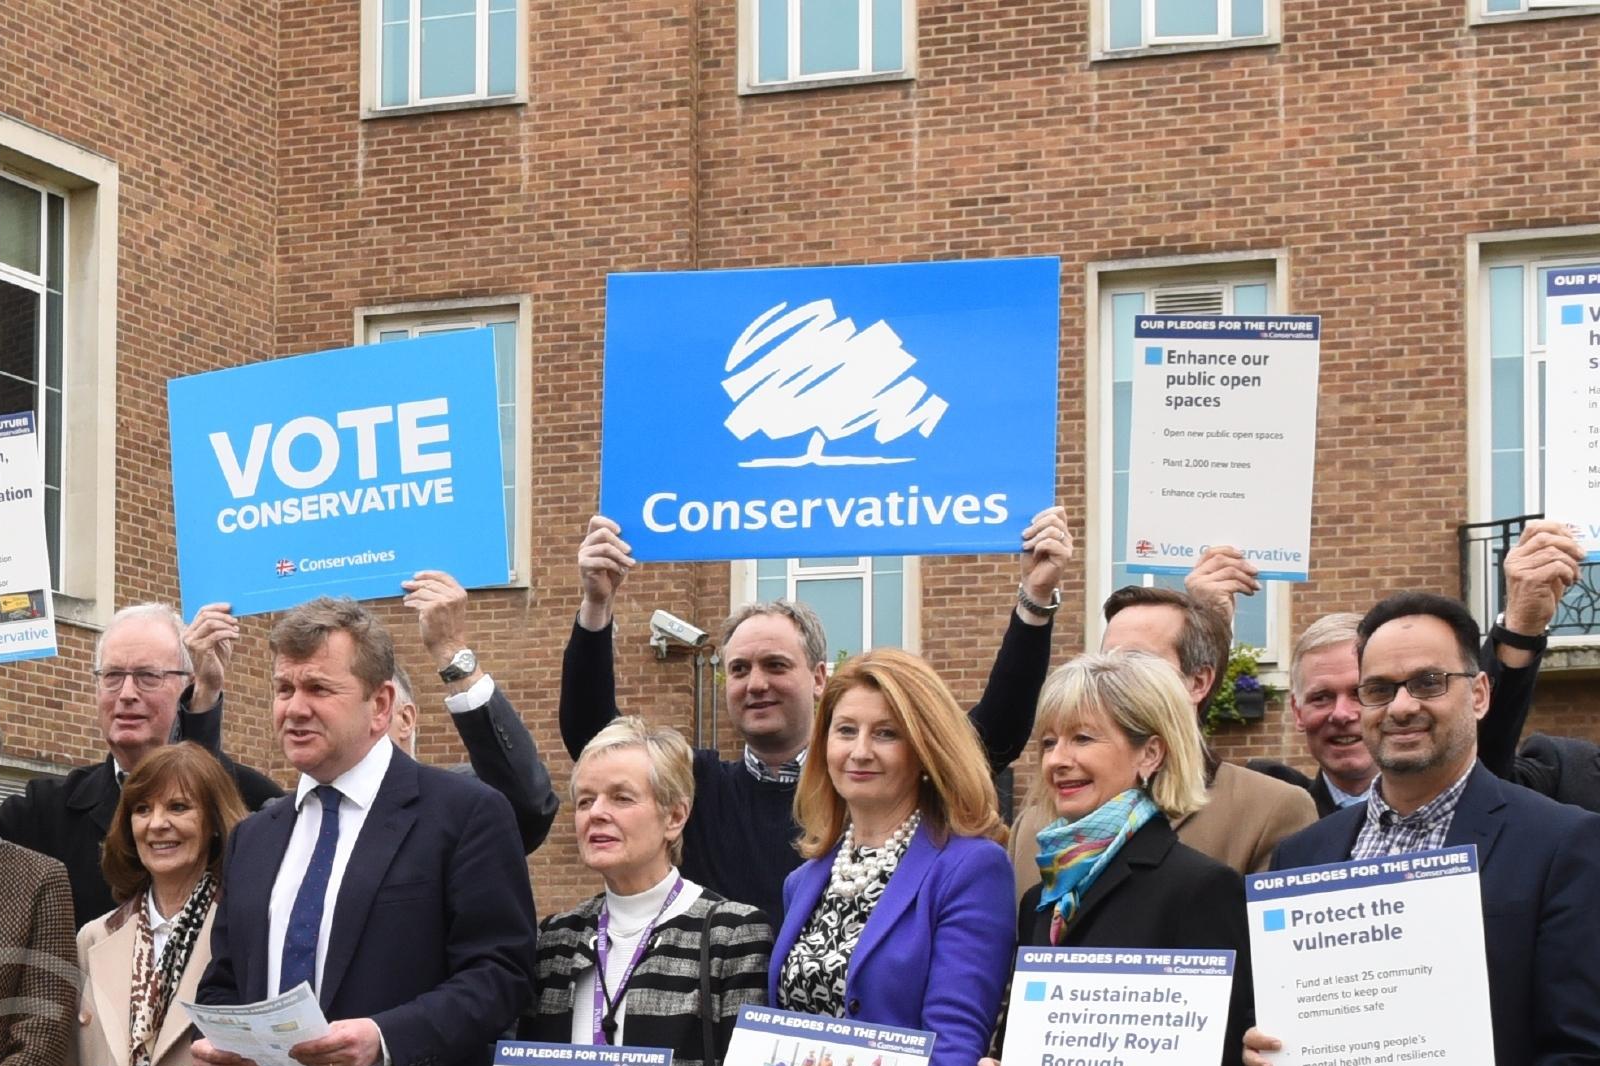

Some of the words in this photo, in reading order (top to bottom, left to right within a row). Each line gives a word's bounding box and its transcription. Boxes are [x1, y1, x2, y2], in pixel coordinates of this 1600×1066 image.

[1554, 274, 1585, 285] OUR
[1140, 320, 1165, 330] OUR
[1166, 320, 1217, 330] PLEDGES
[1218, 320, 1242, 330] FOR
[1242, 321, 1266, 331] THE
[1267, 321, 1313, 331] FUTURE
[1167, 349, 1237, 366] Enhance
[1241, 354, 1270, 366] our
[1166, 370, 1216, 389] public
[1219, 375, 1261, 390] open
[1165, 395, 1221, 411] spaces
[208, 398, 452, 499] VOTE
[217, 477, 454, 533] CONSERVATIVE
[642, 485, 1009, 533] Conservatives
[299, 550, 395, 573] Conservatives
[1253, 877, 1284, 891] OUR
[1286, 868, 1348, 887] PLEDGES
[1350, 864, 1379, 878] FOR
[1380, 860, 1410, 874] THE
[1411, 852, 1469, 870] FUTURE
[1291, 902, 1366, 927] Protect
[1370, 898, 1405, 917] the
[1292, 923, 1403, 952] vulnerable
[1023, 952, 1054, 963] OUR
[1054, 953, 1113, 964] PLEDGES
[1114, 953, 1143, 965] FOR
[1144, 954, 1172, 965] THE
[1172, 954, 1227, 967] FUTURE
[1295, 977, 1321, 989] Fund
[1322, 976, 1333, 986] at
[1334, 973, 1359, 985] least
[1361, 970, 1375, 981] 25
[1376, 964, 1433, 980] community
[1050, 984, 1064, 1001] A
[1069, 985, 1188, 1006] sustainable,
[1296, 992, 1340, 1004] wardens
[1341, 990, 1352, 999] to
[1353, 987, 1379, 998] keep
[1380, 985, 1398, 994] our
[1047, 1007, 1208, 1032] environmentally
[1044, 1030, 1119, 1053] friendly
[1123, 1032, 1180, 1054] Royal
[1339, 1055, 1372, 1066] health
[1374, 1052, 1394, 1064] and
[1396, 1049, 1446, 1062] resilience
